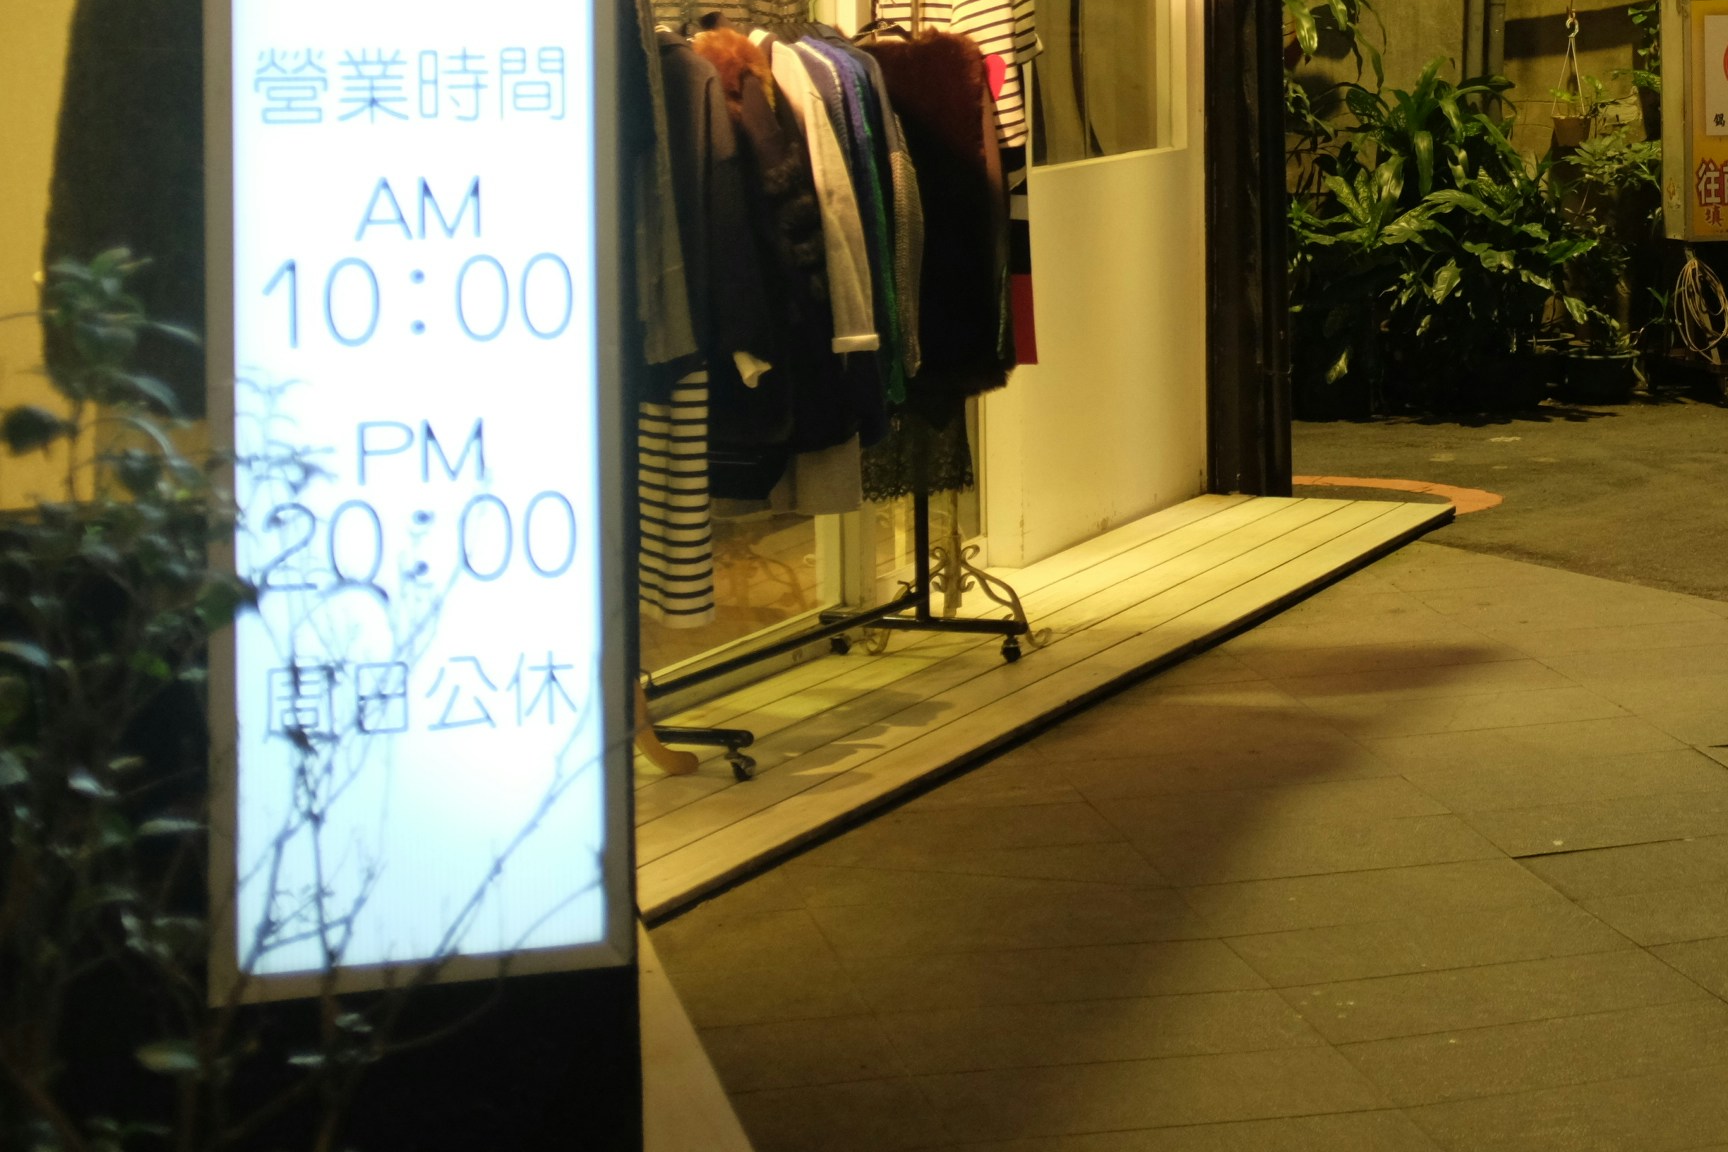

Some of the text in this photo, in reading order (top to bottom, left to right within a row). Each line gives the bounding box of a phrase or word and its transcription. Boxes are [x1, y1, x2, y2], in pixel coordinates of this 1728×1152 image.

[253, 46, 566, 125] 營業時間
[354, 175, 481, 242] AM
[261, 251, 574, 349] 10:00
[357, 416, 485, 486] PM
[261, 490, 577, 592] 20:00
[263, 650, 578, 745] 周日公休
